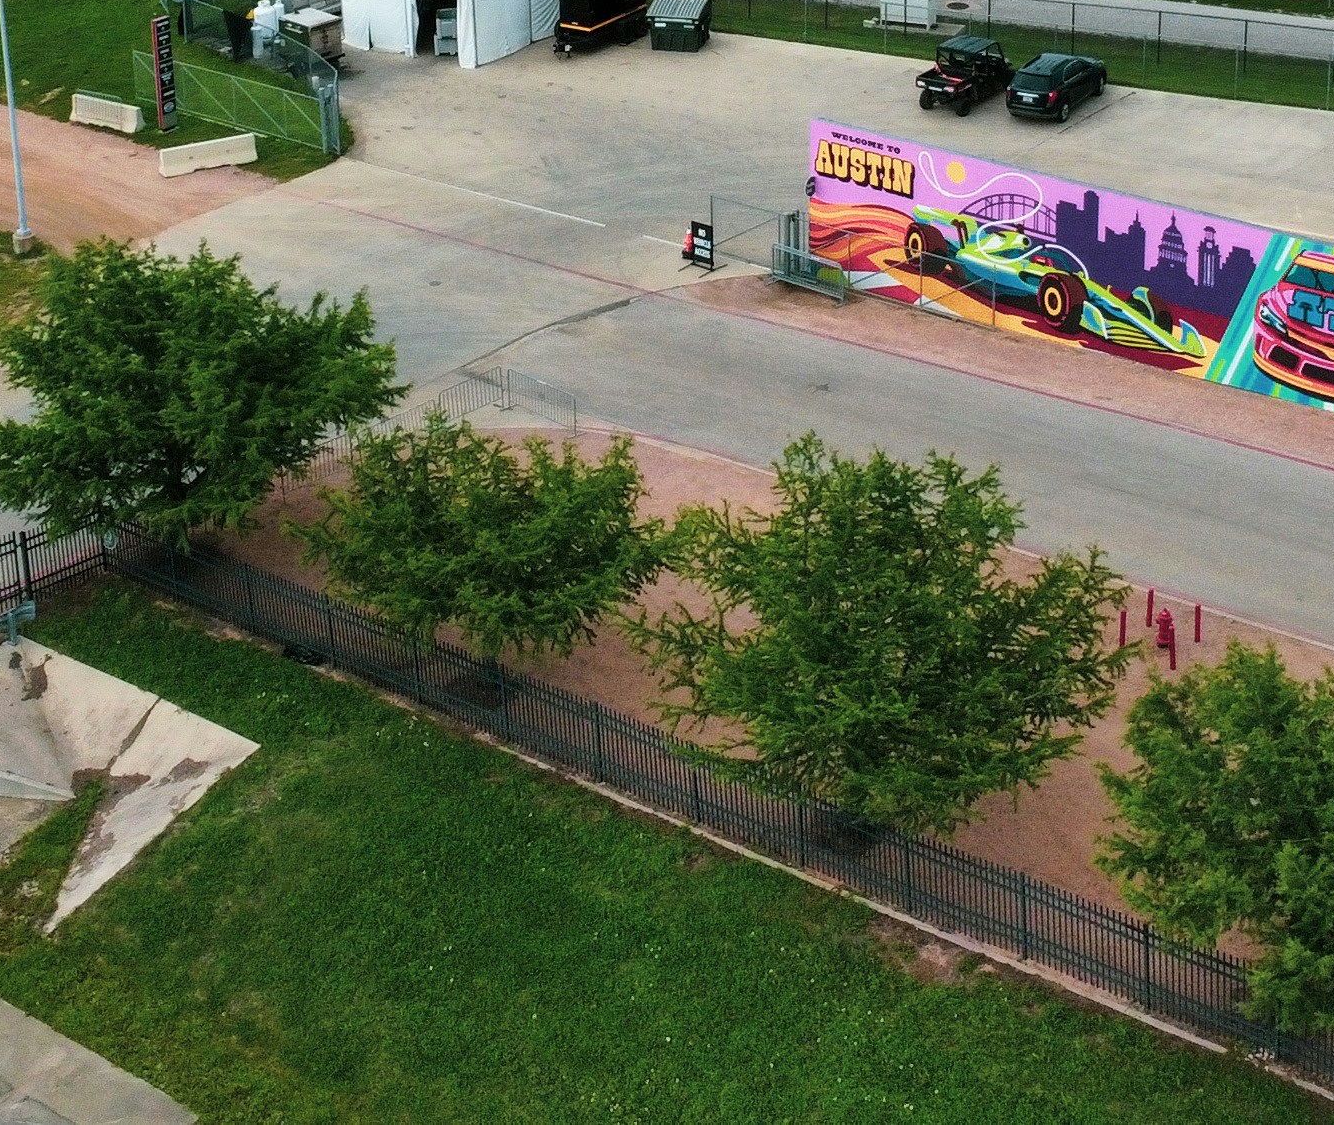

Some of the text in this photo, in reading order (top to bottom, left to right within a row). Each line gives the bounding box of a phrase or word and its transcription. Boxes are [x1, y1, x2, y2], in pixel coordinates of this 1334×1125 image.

[831, 131, 901, 154] WELCOME TO
[815, 139, 915, 199] AUSTIN
